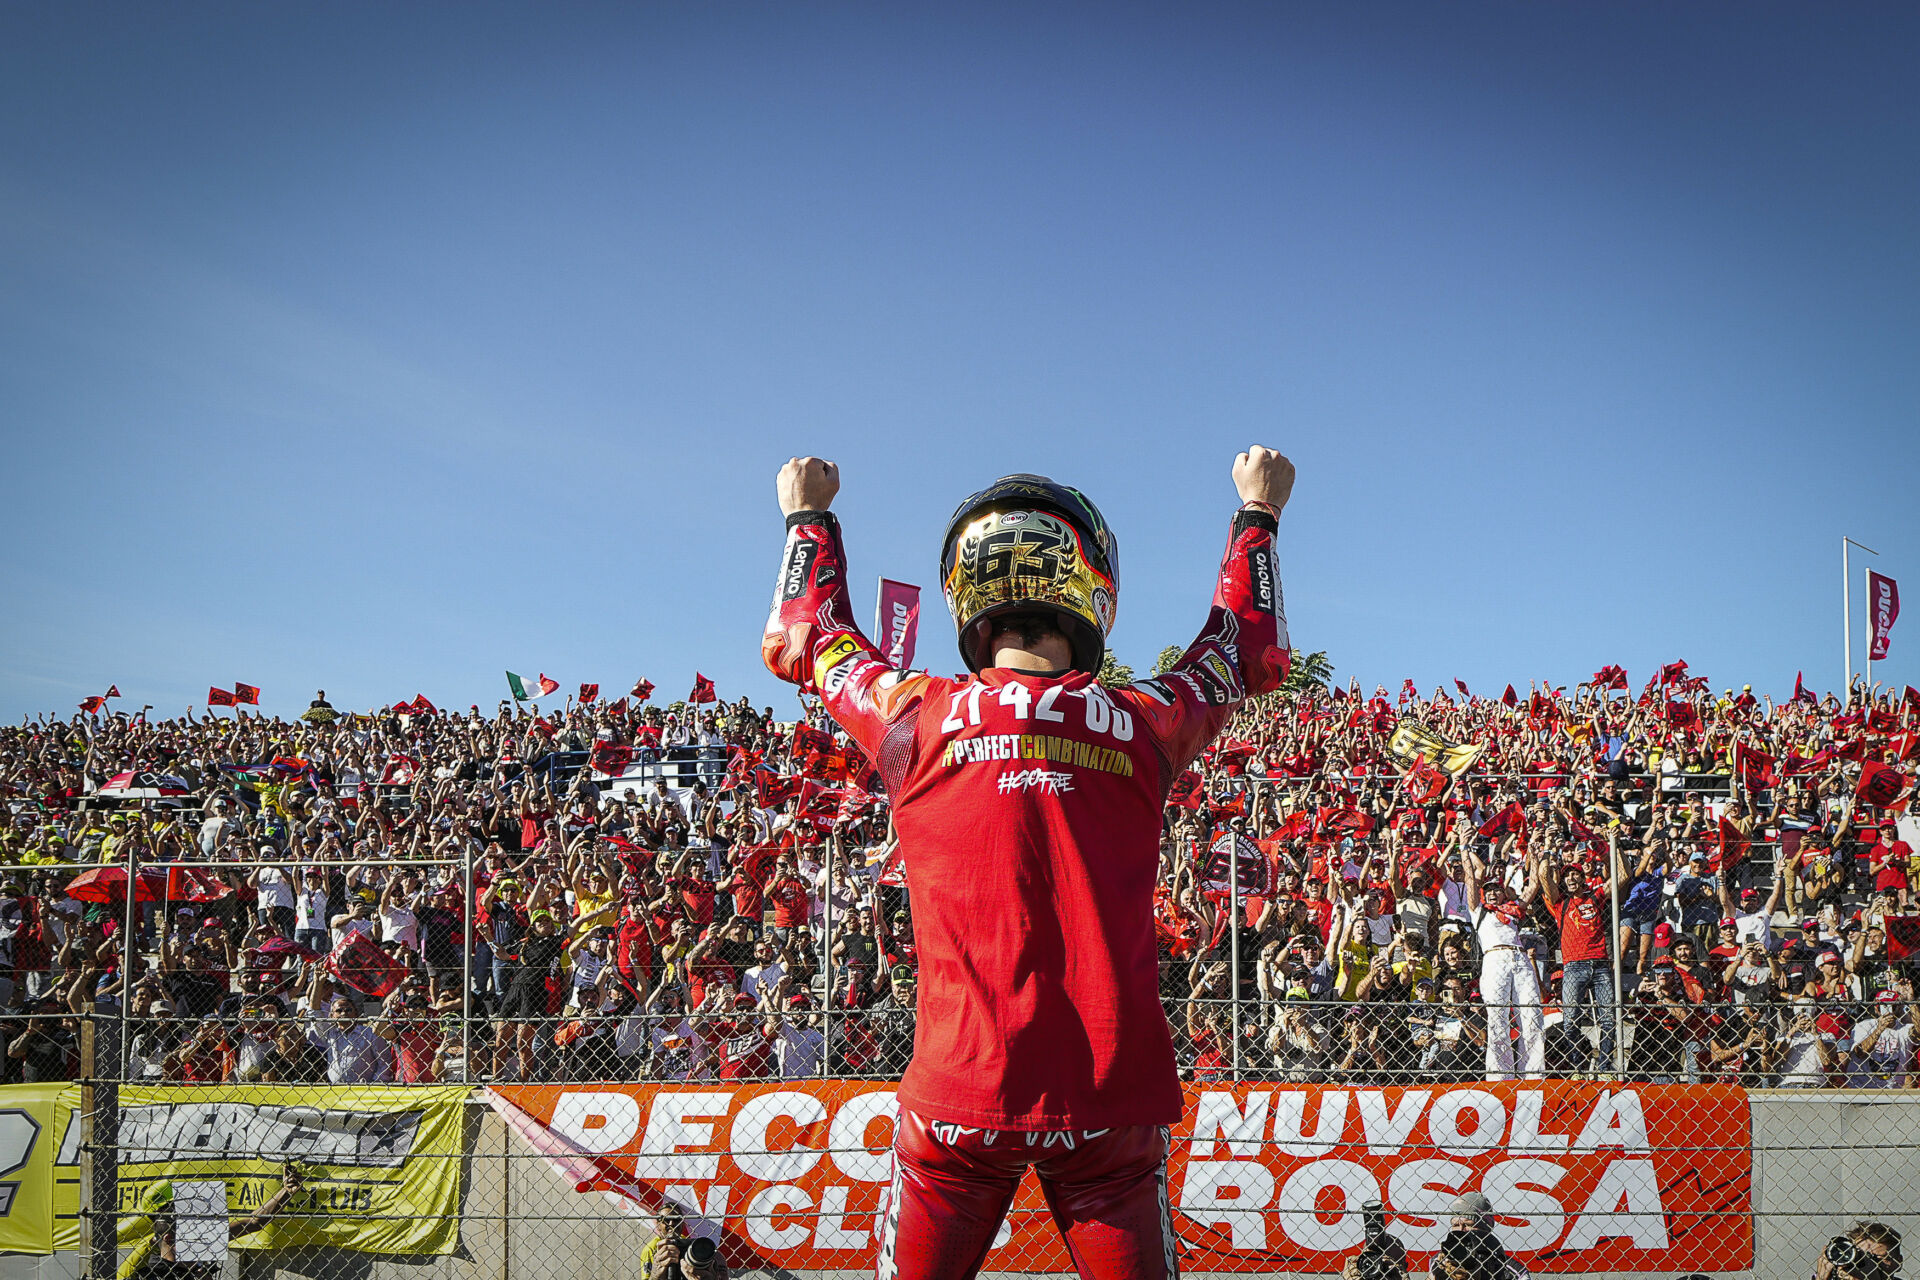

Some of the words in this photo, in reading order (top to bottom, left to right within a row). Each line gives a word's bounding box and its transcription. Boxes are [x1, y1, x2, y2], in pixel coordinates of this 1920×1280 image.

[788, 543, 813, 595] Lenovo
[976, 529, 1064, 588] 63
[1256, 552, 1272, 610] Lenovo
[549, 1091, 898, 1182] PECC
[1191, 1088, 1652, 1158] NUVOLA
[1178, 1158, 1672, 1253] ROSSA
